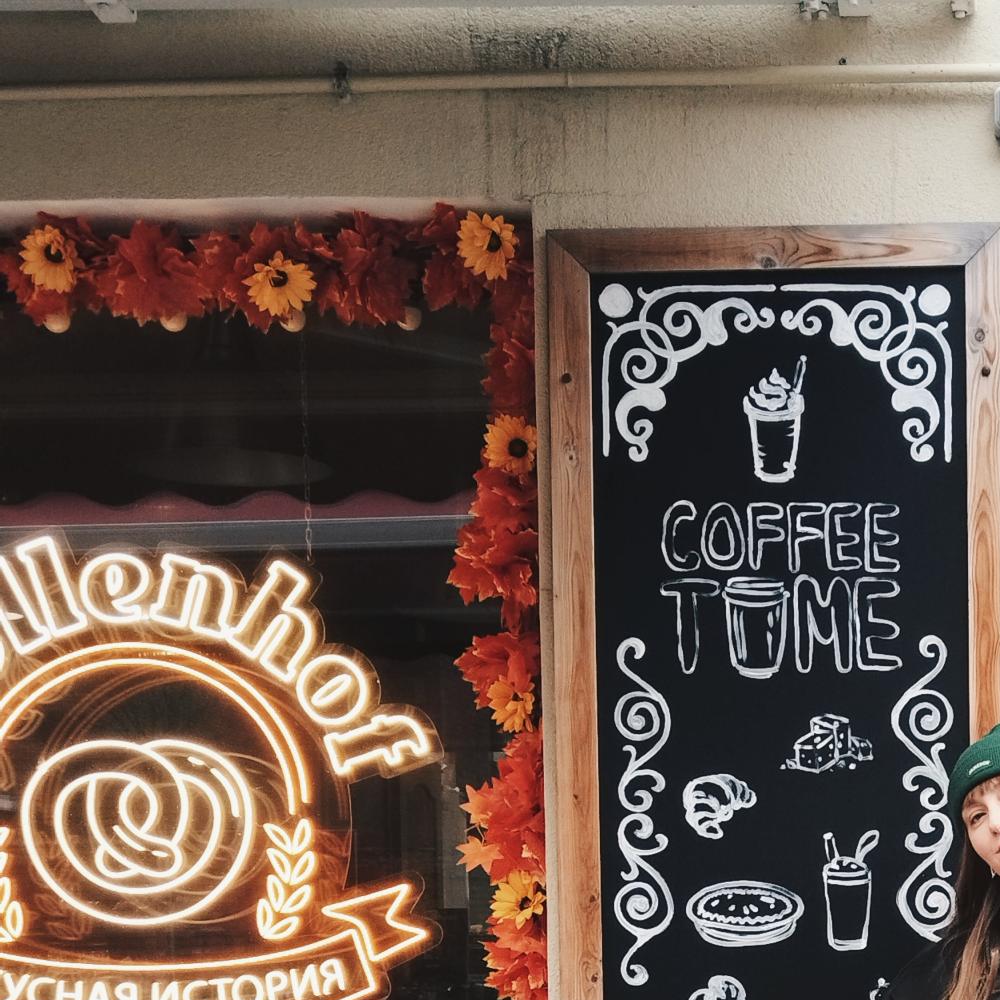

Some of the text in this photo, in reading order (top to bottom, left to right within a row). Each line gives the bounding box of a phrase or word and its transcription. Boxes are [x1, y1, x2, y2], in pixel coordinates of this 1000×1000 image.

[661, 500, 901, 573] COFFEE
[0, 535, 430, 777] llenhof
[660, 574, 903, 679] TME
